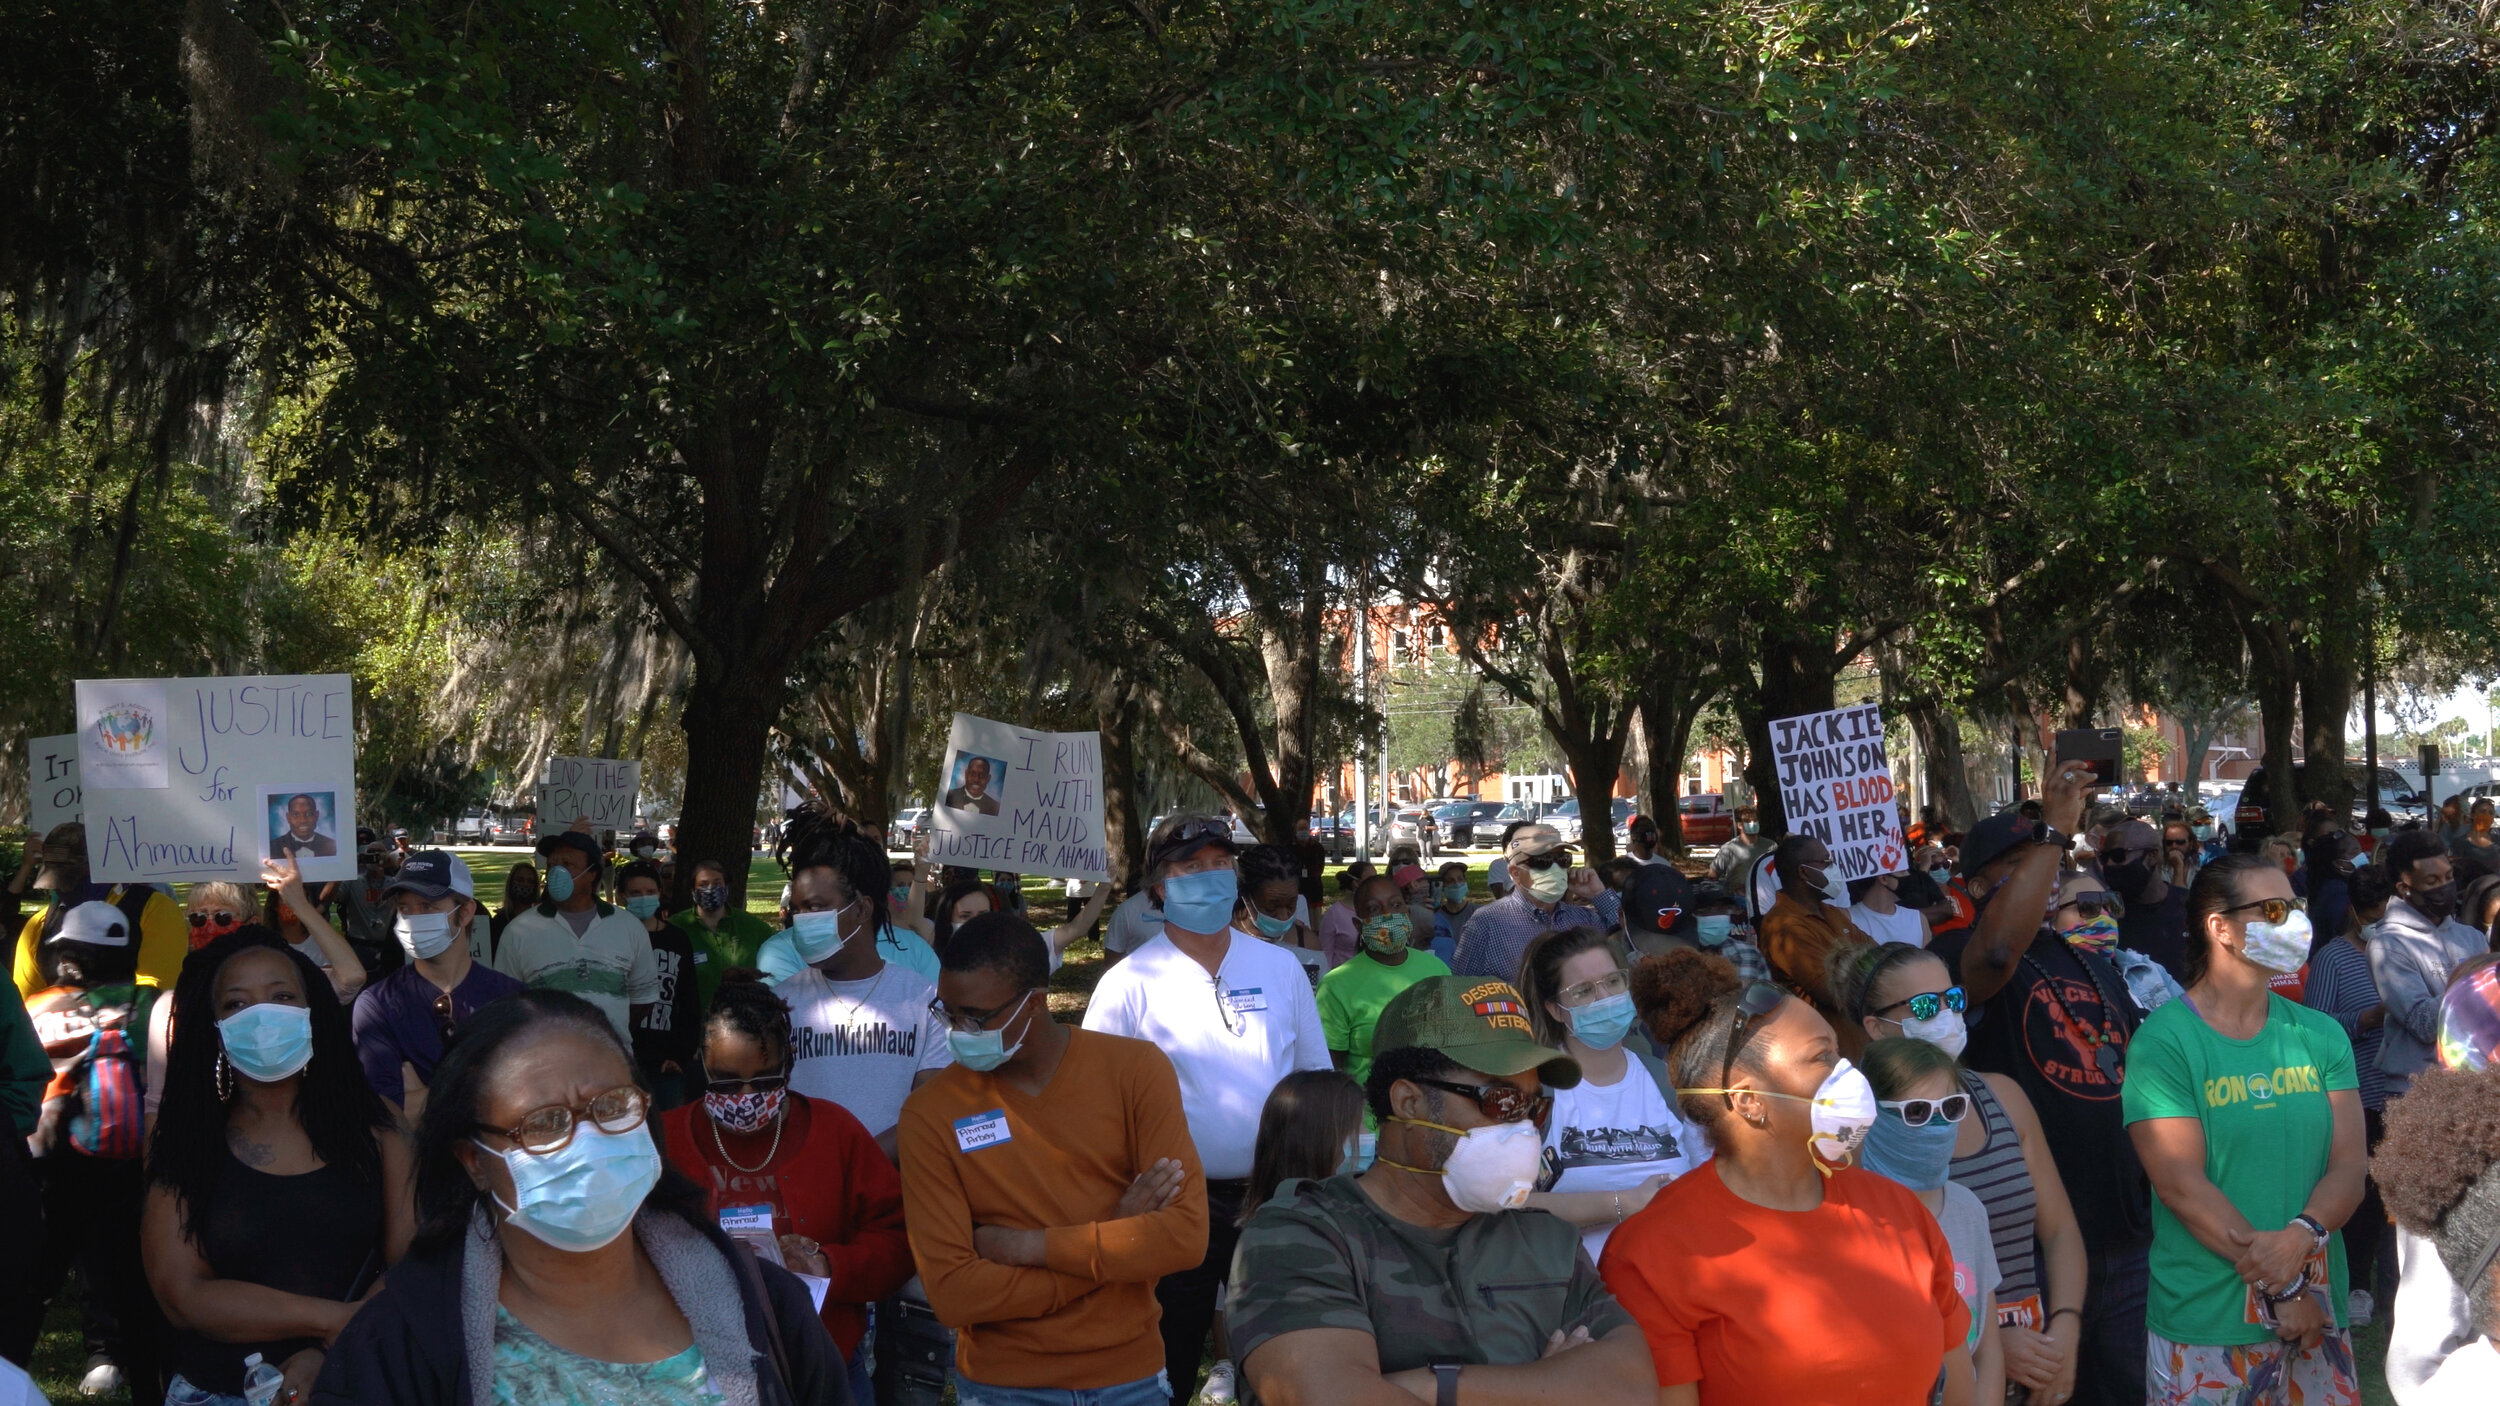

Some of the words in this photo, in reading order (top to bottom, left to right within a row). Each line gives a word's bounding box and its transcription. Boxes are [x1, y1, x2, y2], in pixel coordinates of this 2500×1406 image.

[180, 685, 345, 775] JUSTICE
[1775, 707, 1882, 754] JACKIE
[1015, 736, 1042, 772] I
[1054, 739, 1094, 775] RUN
[1780, 742, 1888, 787] JOHNSON
[199, 766, 239, 802] for
[550, 758, 584, 787] END
[591, 763, 631, 790] THE
[1036, 779, 1093, 812] WITH
[1784, 784, 1829, 819] HAS
[1832, 775, 1894, 811] BLOOD
[1013, 809, 1088, 844] MAUD
[1799, 817, 1833, 845] ON
[1839, 810, 1890, 842] HER
[932, 829, 1015, 859] JUSTICE
[1021, 841, 1048, 864] FOR
[1053, 845, 1109, 872] AHMAUD
[1460, 981, 1509, 1006] DESERT
[791, 1022, 917, 1060] #IRunWithMaud
[958, 1120, 996, 1137] Ahmaud
[1607, 1142, 1633, 1152] WITH
[1635, 1143, 1662, 1152] MAUD
[709, 1165, 779, 1193] New
[722, 1215, 760, 1226] Ahmaud
